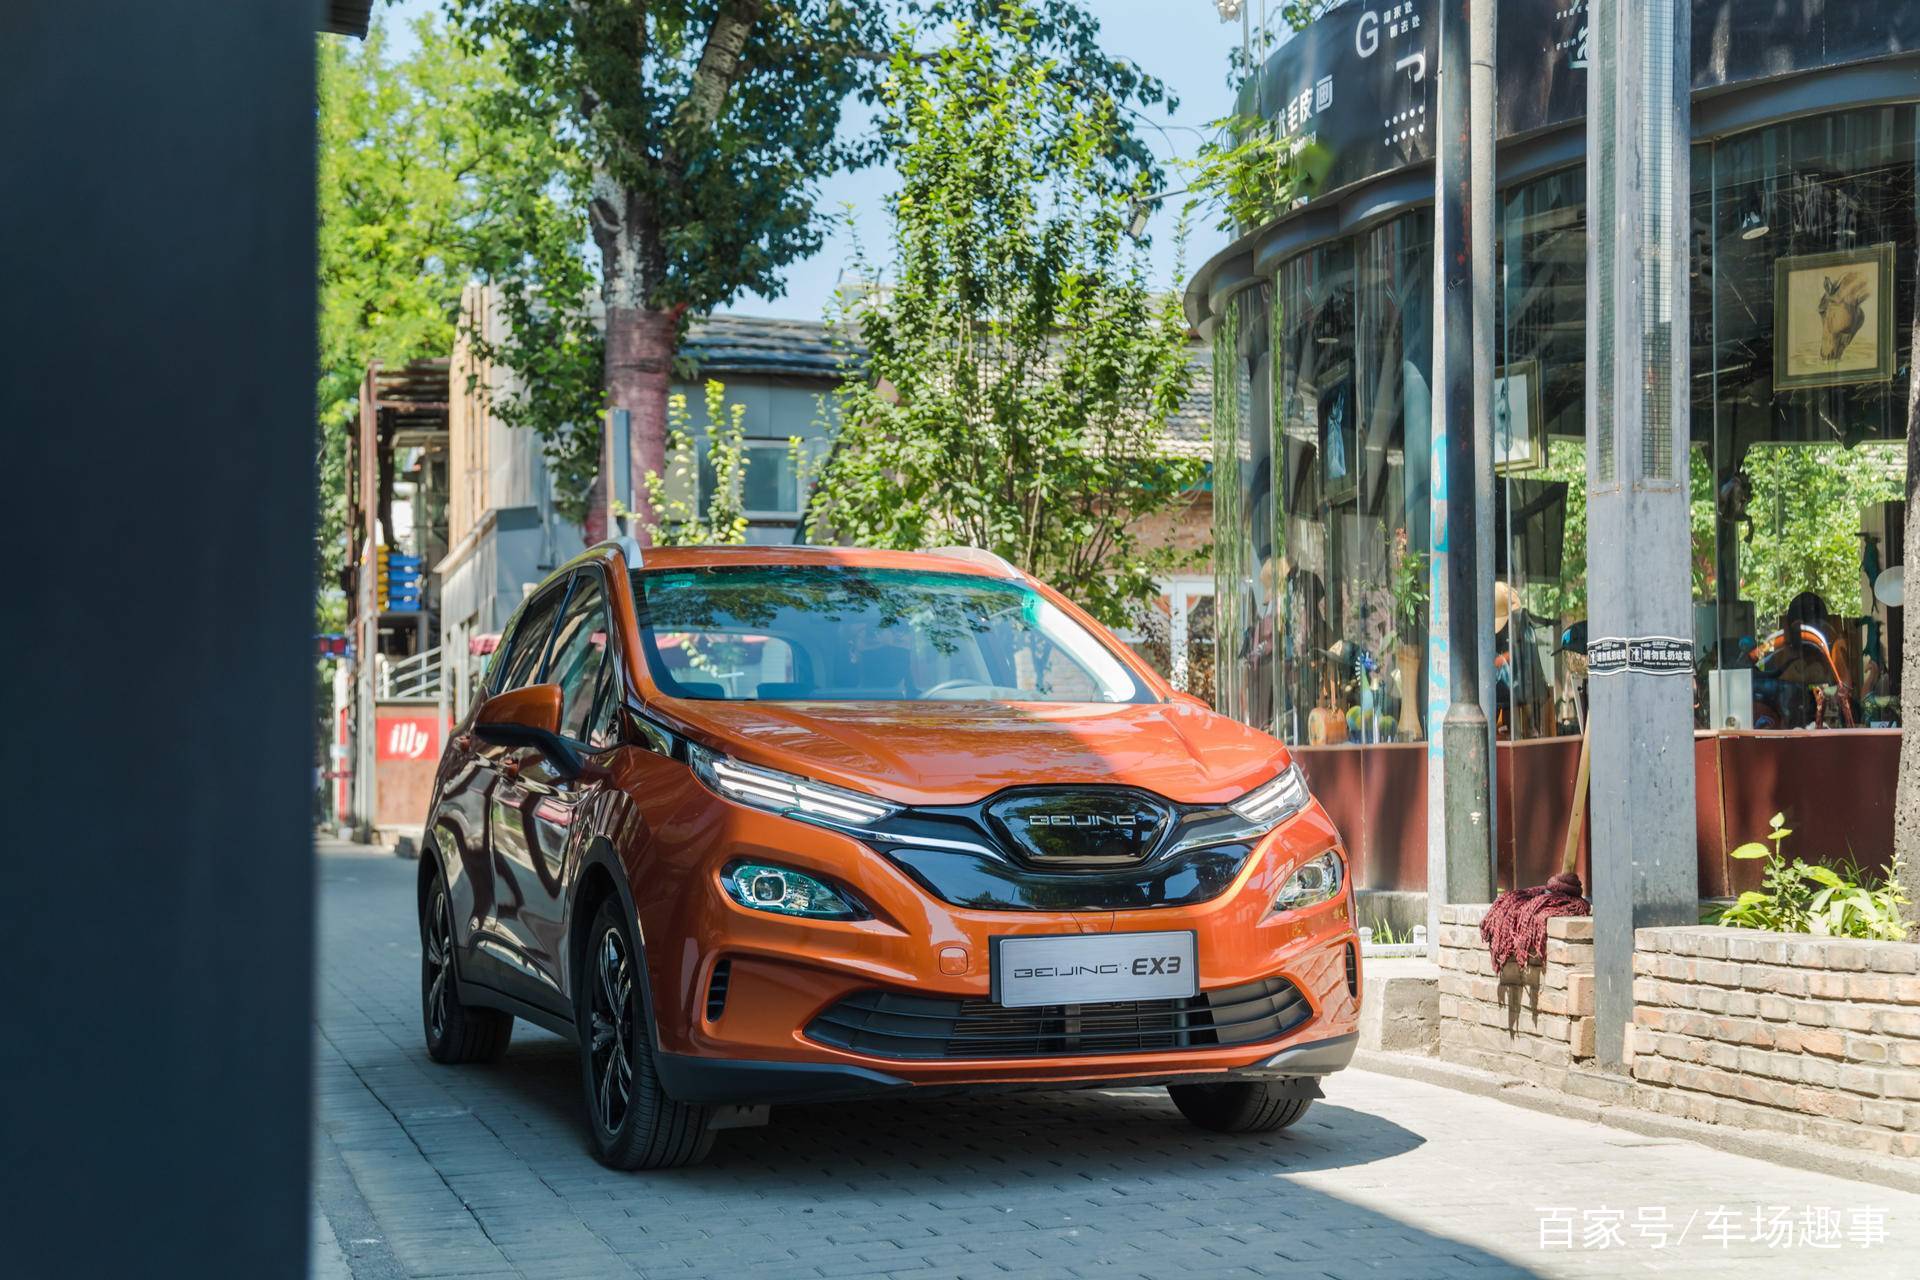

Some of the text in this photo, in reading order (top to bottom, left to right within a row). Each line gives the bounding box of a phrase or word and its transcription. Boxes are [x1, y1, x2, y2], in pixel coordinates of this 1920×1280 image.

[389, 722, 429, 758] illy
[1029, 815, 1137, 826] BEIJING
[1131, 956, 1182, 976] EX3
